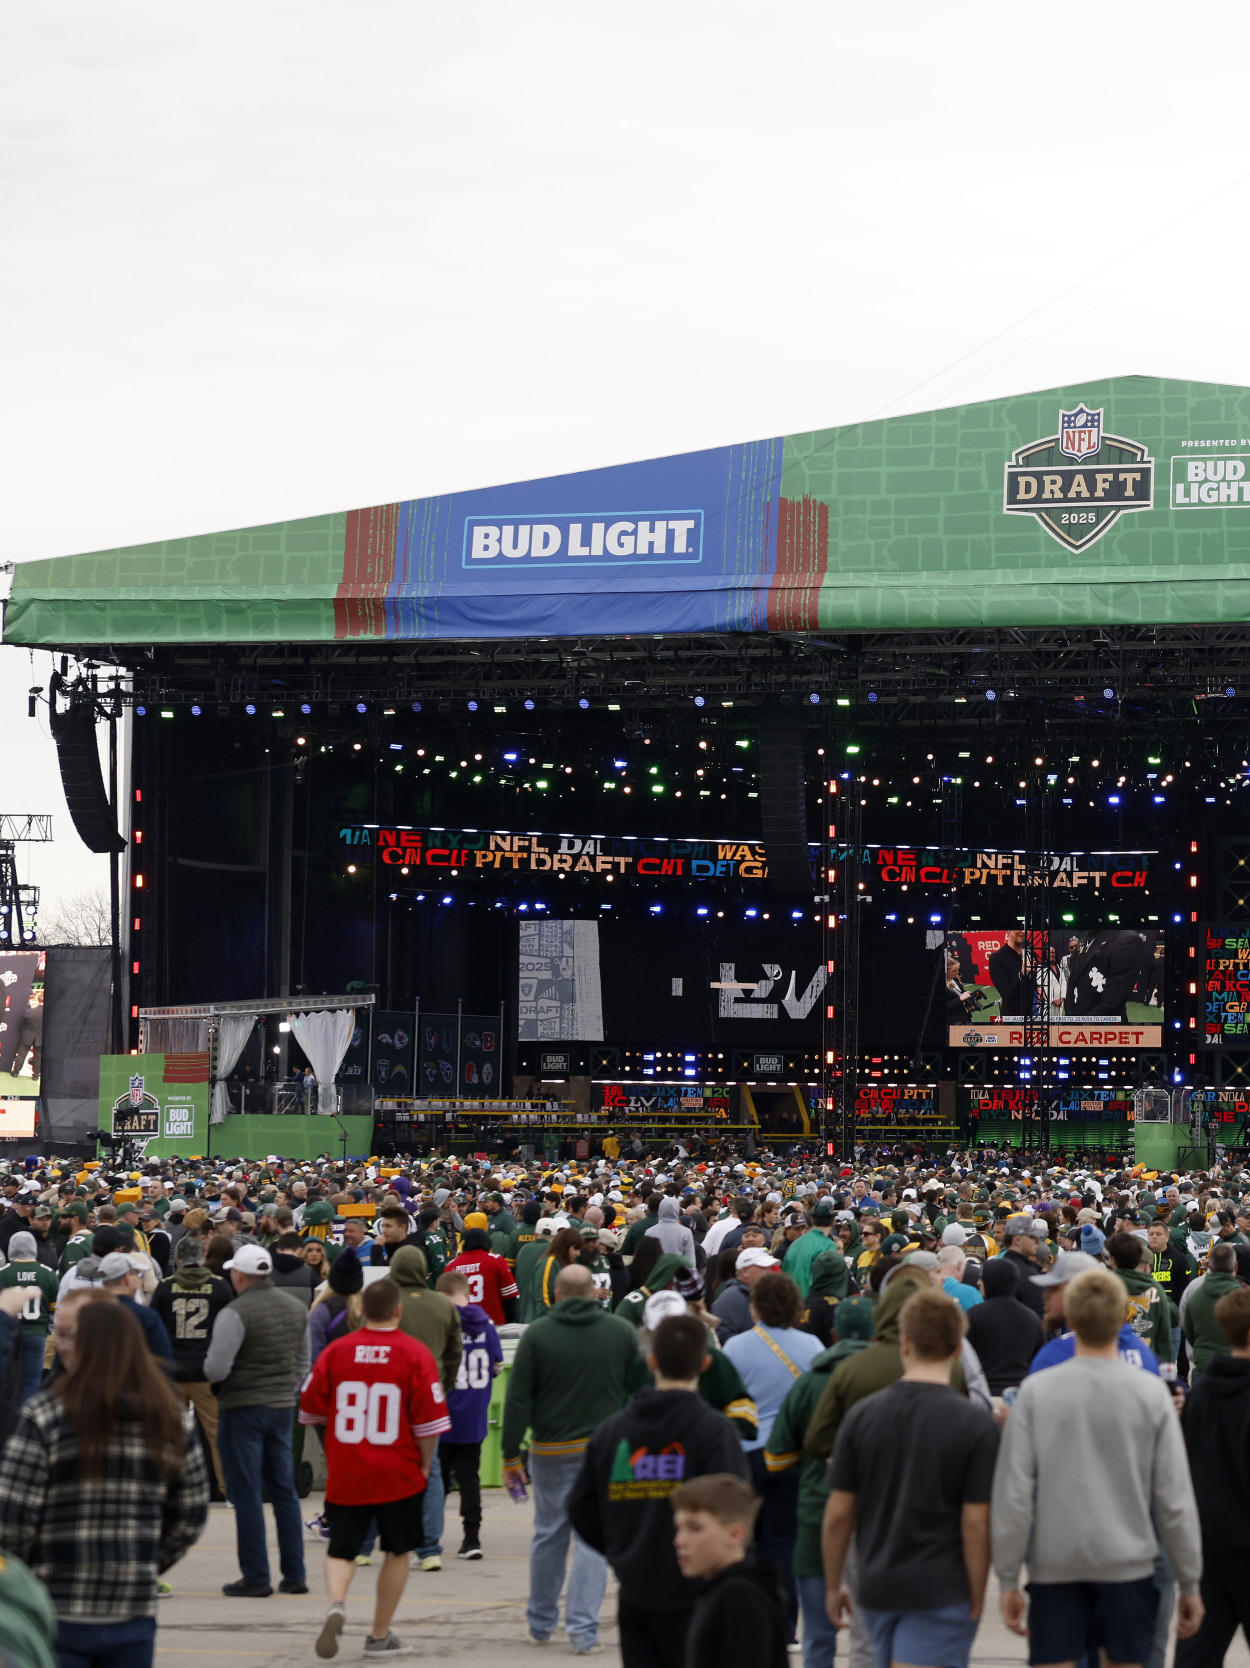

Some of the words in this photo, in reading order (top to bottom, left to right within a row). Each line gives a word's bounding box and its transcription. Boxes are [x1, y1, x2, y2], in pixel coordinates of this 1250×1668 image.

[1064, 429, 1097, 454] NFL
[1181, 440, 1238, 448] PRESENTED
[1187, 460, 1246, 482] BUD
[1016, 473, 1141, 500] DRAFT
[1061, 513, 1096, 525] 2025
[471, 524, 562, 559] BUD
[567, 520, 696, 557] LIGHT
[377, 830, 423, 848] NE
[488, 835, 549, 853] NFL
[558, 838, 604, 856] DAL
[381, 847, 422, 866] CIN
[474, 850, 529, 869] PIT
[530, 852, 633, 874] DRAFT
[637, 857, 686, 876] CHI
[691, 859, 737, 877] DET
[877, 850, 918, 866] NE
[976, 852, 1027, 869] NFL
[881, 866, 916, 883] CIN
[964, 867, 1011, 886] PIT
[977, 940, 1001, 951] RED
[1225, 938, 1249, 950] SEA
[519, 962, 551, 972] 2025
[1218, 959, 1250, 971] PIT
[1224, 981, 1249, 992] KC
[520, 1005, 561, 1015] DRAFT
[1223, 1023, 1249, 1035] SEA
[1058, 1031, 1145, 1045] CARPET
[543, 1062, 568, 1070] LIGHT
[546, 1055, 565, 1063] BUD
[760, 1057, 779, 1065] BUD
[756, 1064, 782, 1072] LIGHT
[629, 1096, 658, 1107] LV
[1217, 1091, 1245, 1102] NOLA
[169, 1108, 189, 1122] BUD
[166, 1121, 193, 1135] LIGHT
[17, 1271, 37, 1282] LOVE
[467, 1274, 485, 1303] 3
[17, 1286, 42, 1320] 0
[171, 1298, 210, 1339] 12
[354, 1345, 391, 1364] RICE
[335, 1381, 402, 1446] 80
[633, 1454, 686, 1481] REI
